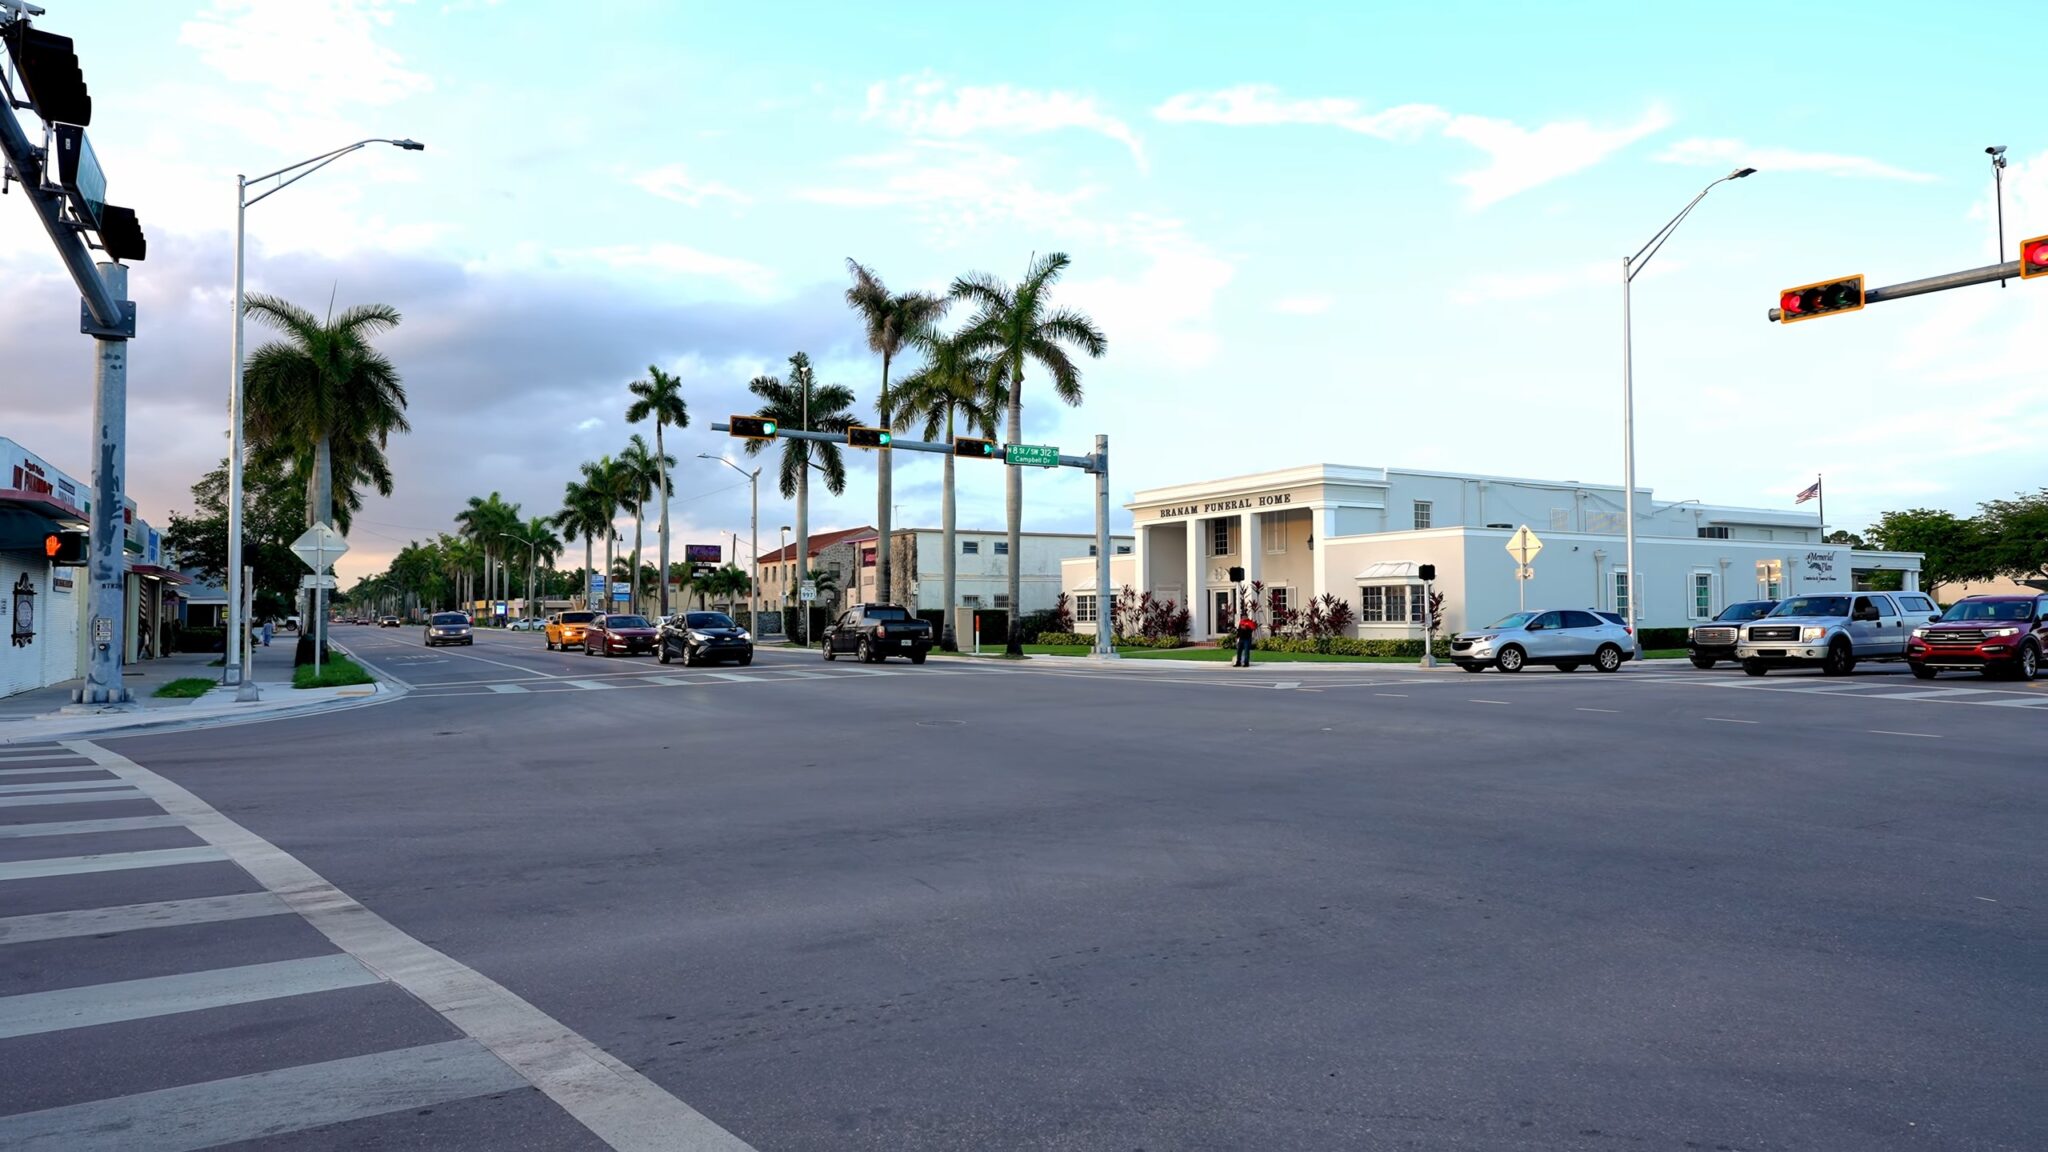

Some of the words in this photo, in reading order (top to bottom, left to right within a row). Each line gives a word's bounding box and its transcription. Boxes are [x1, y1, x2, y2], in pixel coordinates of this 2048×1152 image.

[1013, 447, 1018, 455] 8
[1040, 448, 1052, 457] 312
[1015, 456, 1042, 464] Campbell
[1160, 505, 1198, 518] BRANAM
[1204, 499, 1252, 513] FUNERAL
[1258, 494, 1291, 506] HOME
